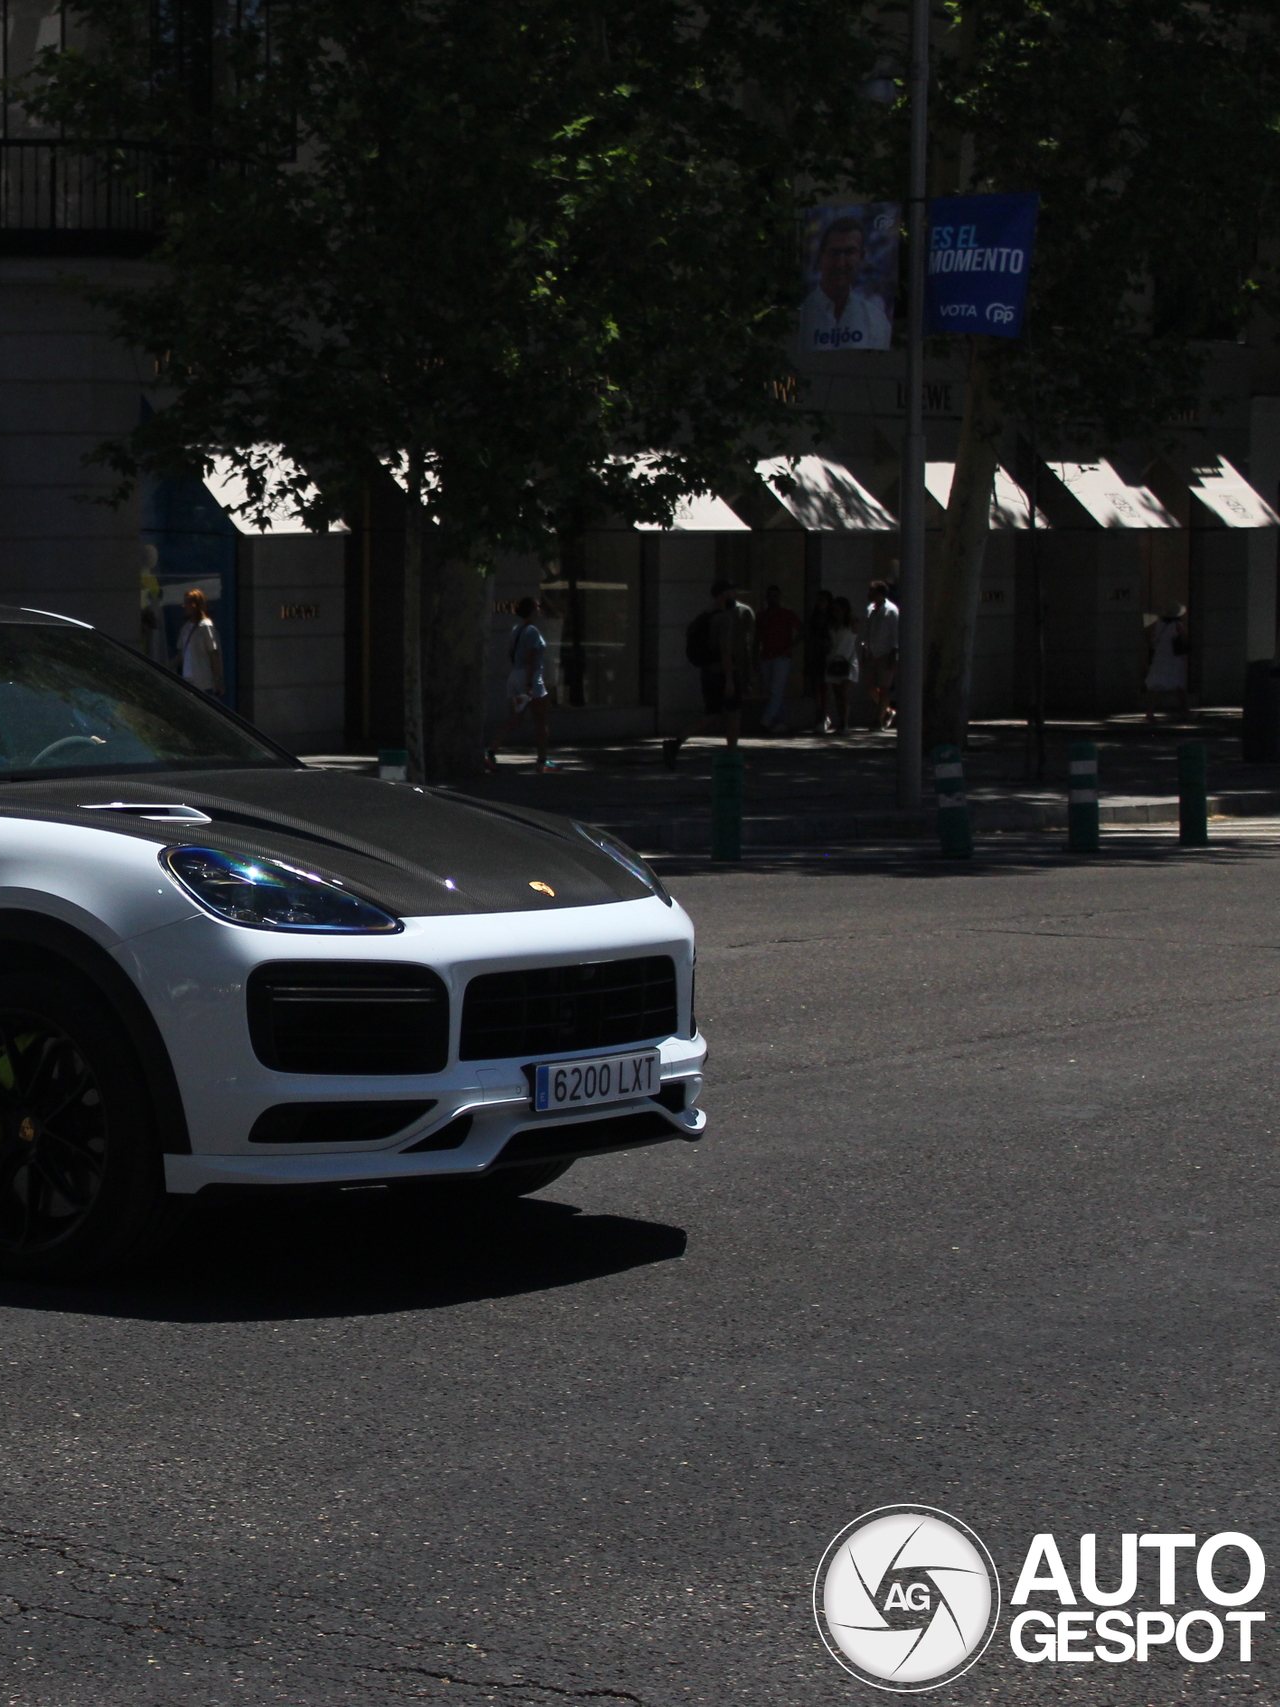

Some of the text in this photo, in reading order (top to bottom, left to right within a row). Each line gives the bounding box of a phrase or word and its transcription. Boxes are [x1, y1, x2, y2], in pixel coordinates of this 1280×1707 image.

[931, 225, 979, 250] ES EL
[928, 248, 1024, 275] MOMENTO
[940, 304, 978, 318] VOTA
[554, 1057, 656, 1103] 6200 LXT
